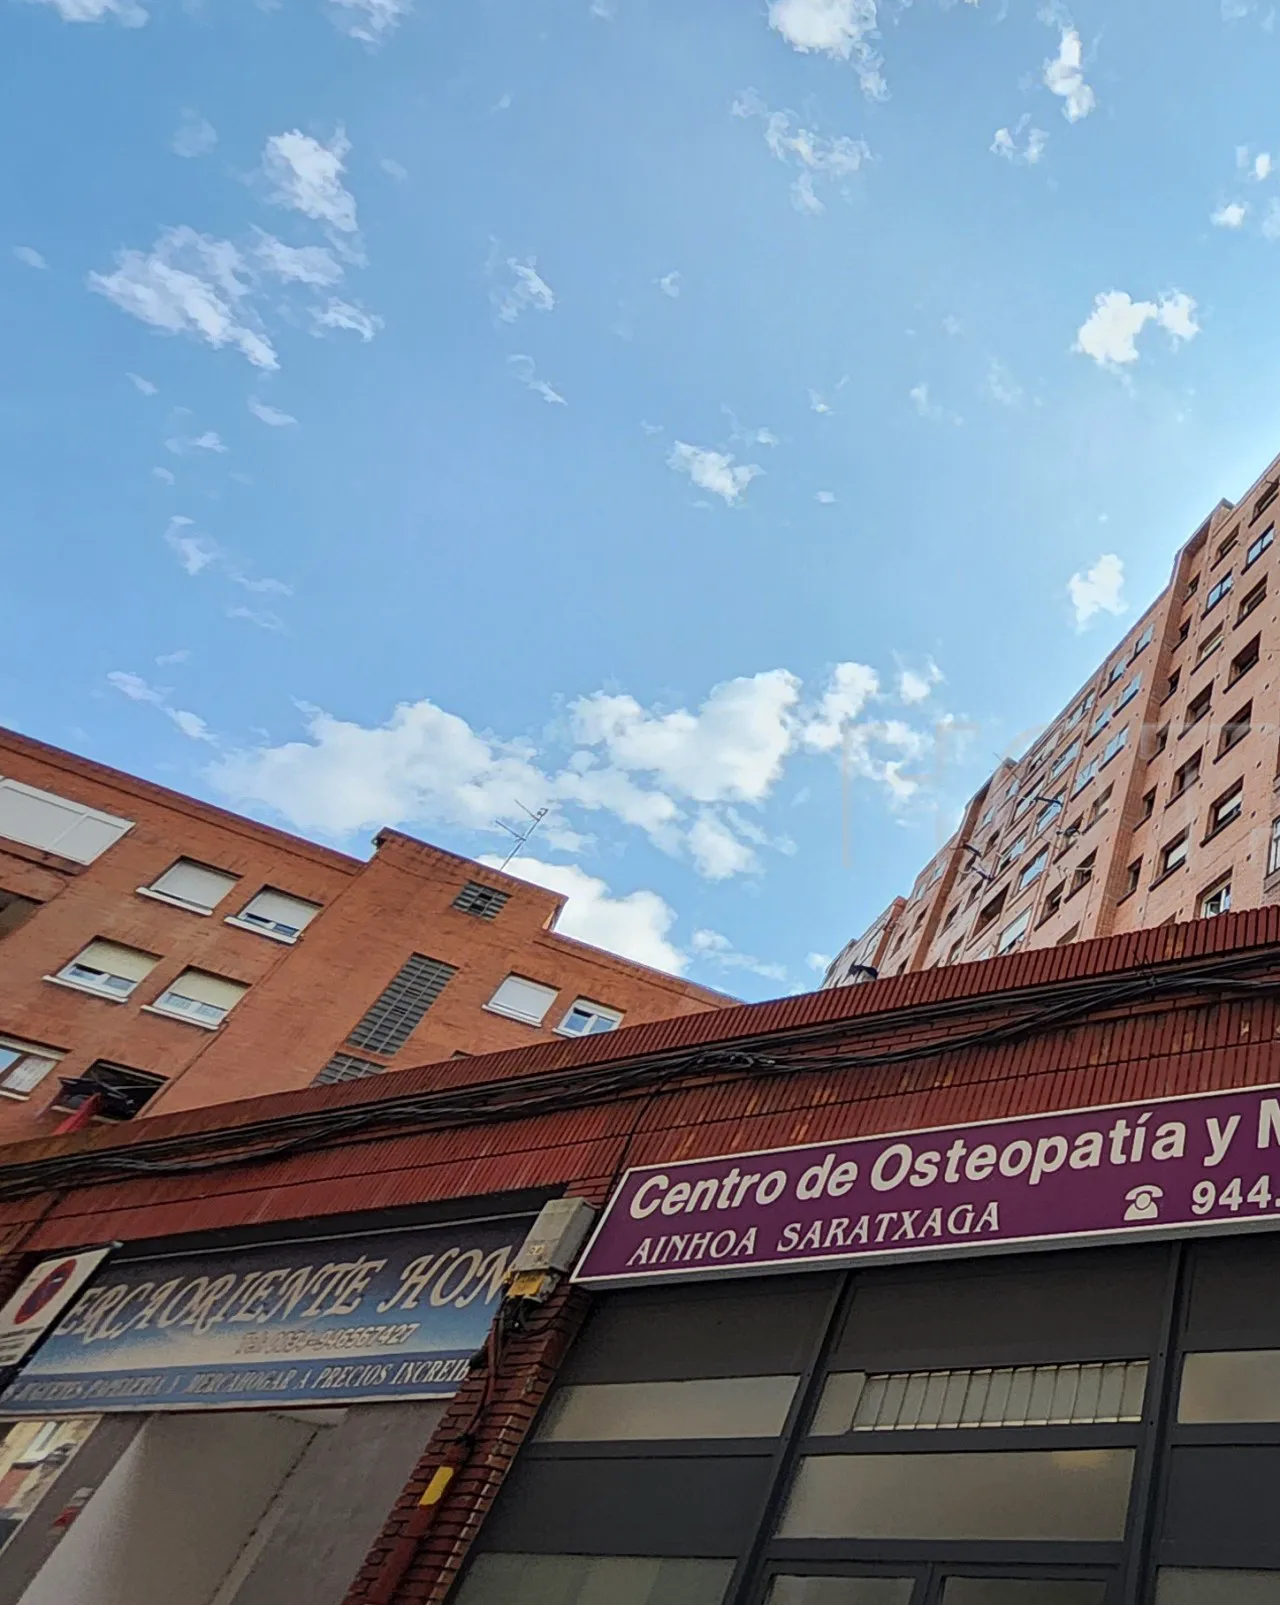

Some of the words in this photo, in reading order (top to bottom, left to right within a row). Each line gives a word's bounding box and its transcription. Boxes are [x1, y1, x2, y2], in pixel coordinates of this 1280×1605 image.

[630, 1167, 787, 1219] Centro
[796, 1153, 859, 1200] de
[871, 1112, 1187, 1193] Osteopatía
[1203, 1115, 1241, 1167] y
[626, 1227, 757, 1266] AINHOA
[777, 1202, 1000, 1253] SARATXAGA
[51, 1256, 388, 1345] ERCAORIENTE
[311, 1363, 394, 1389] PRECIOS
